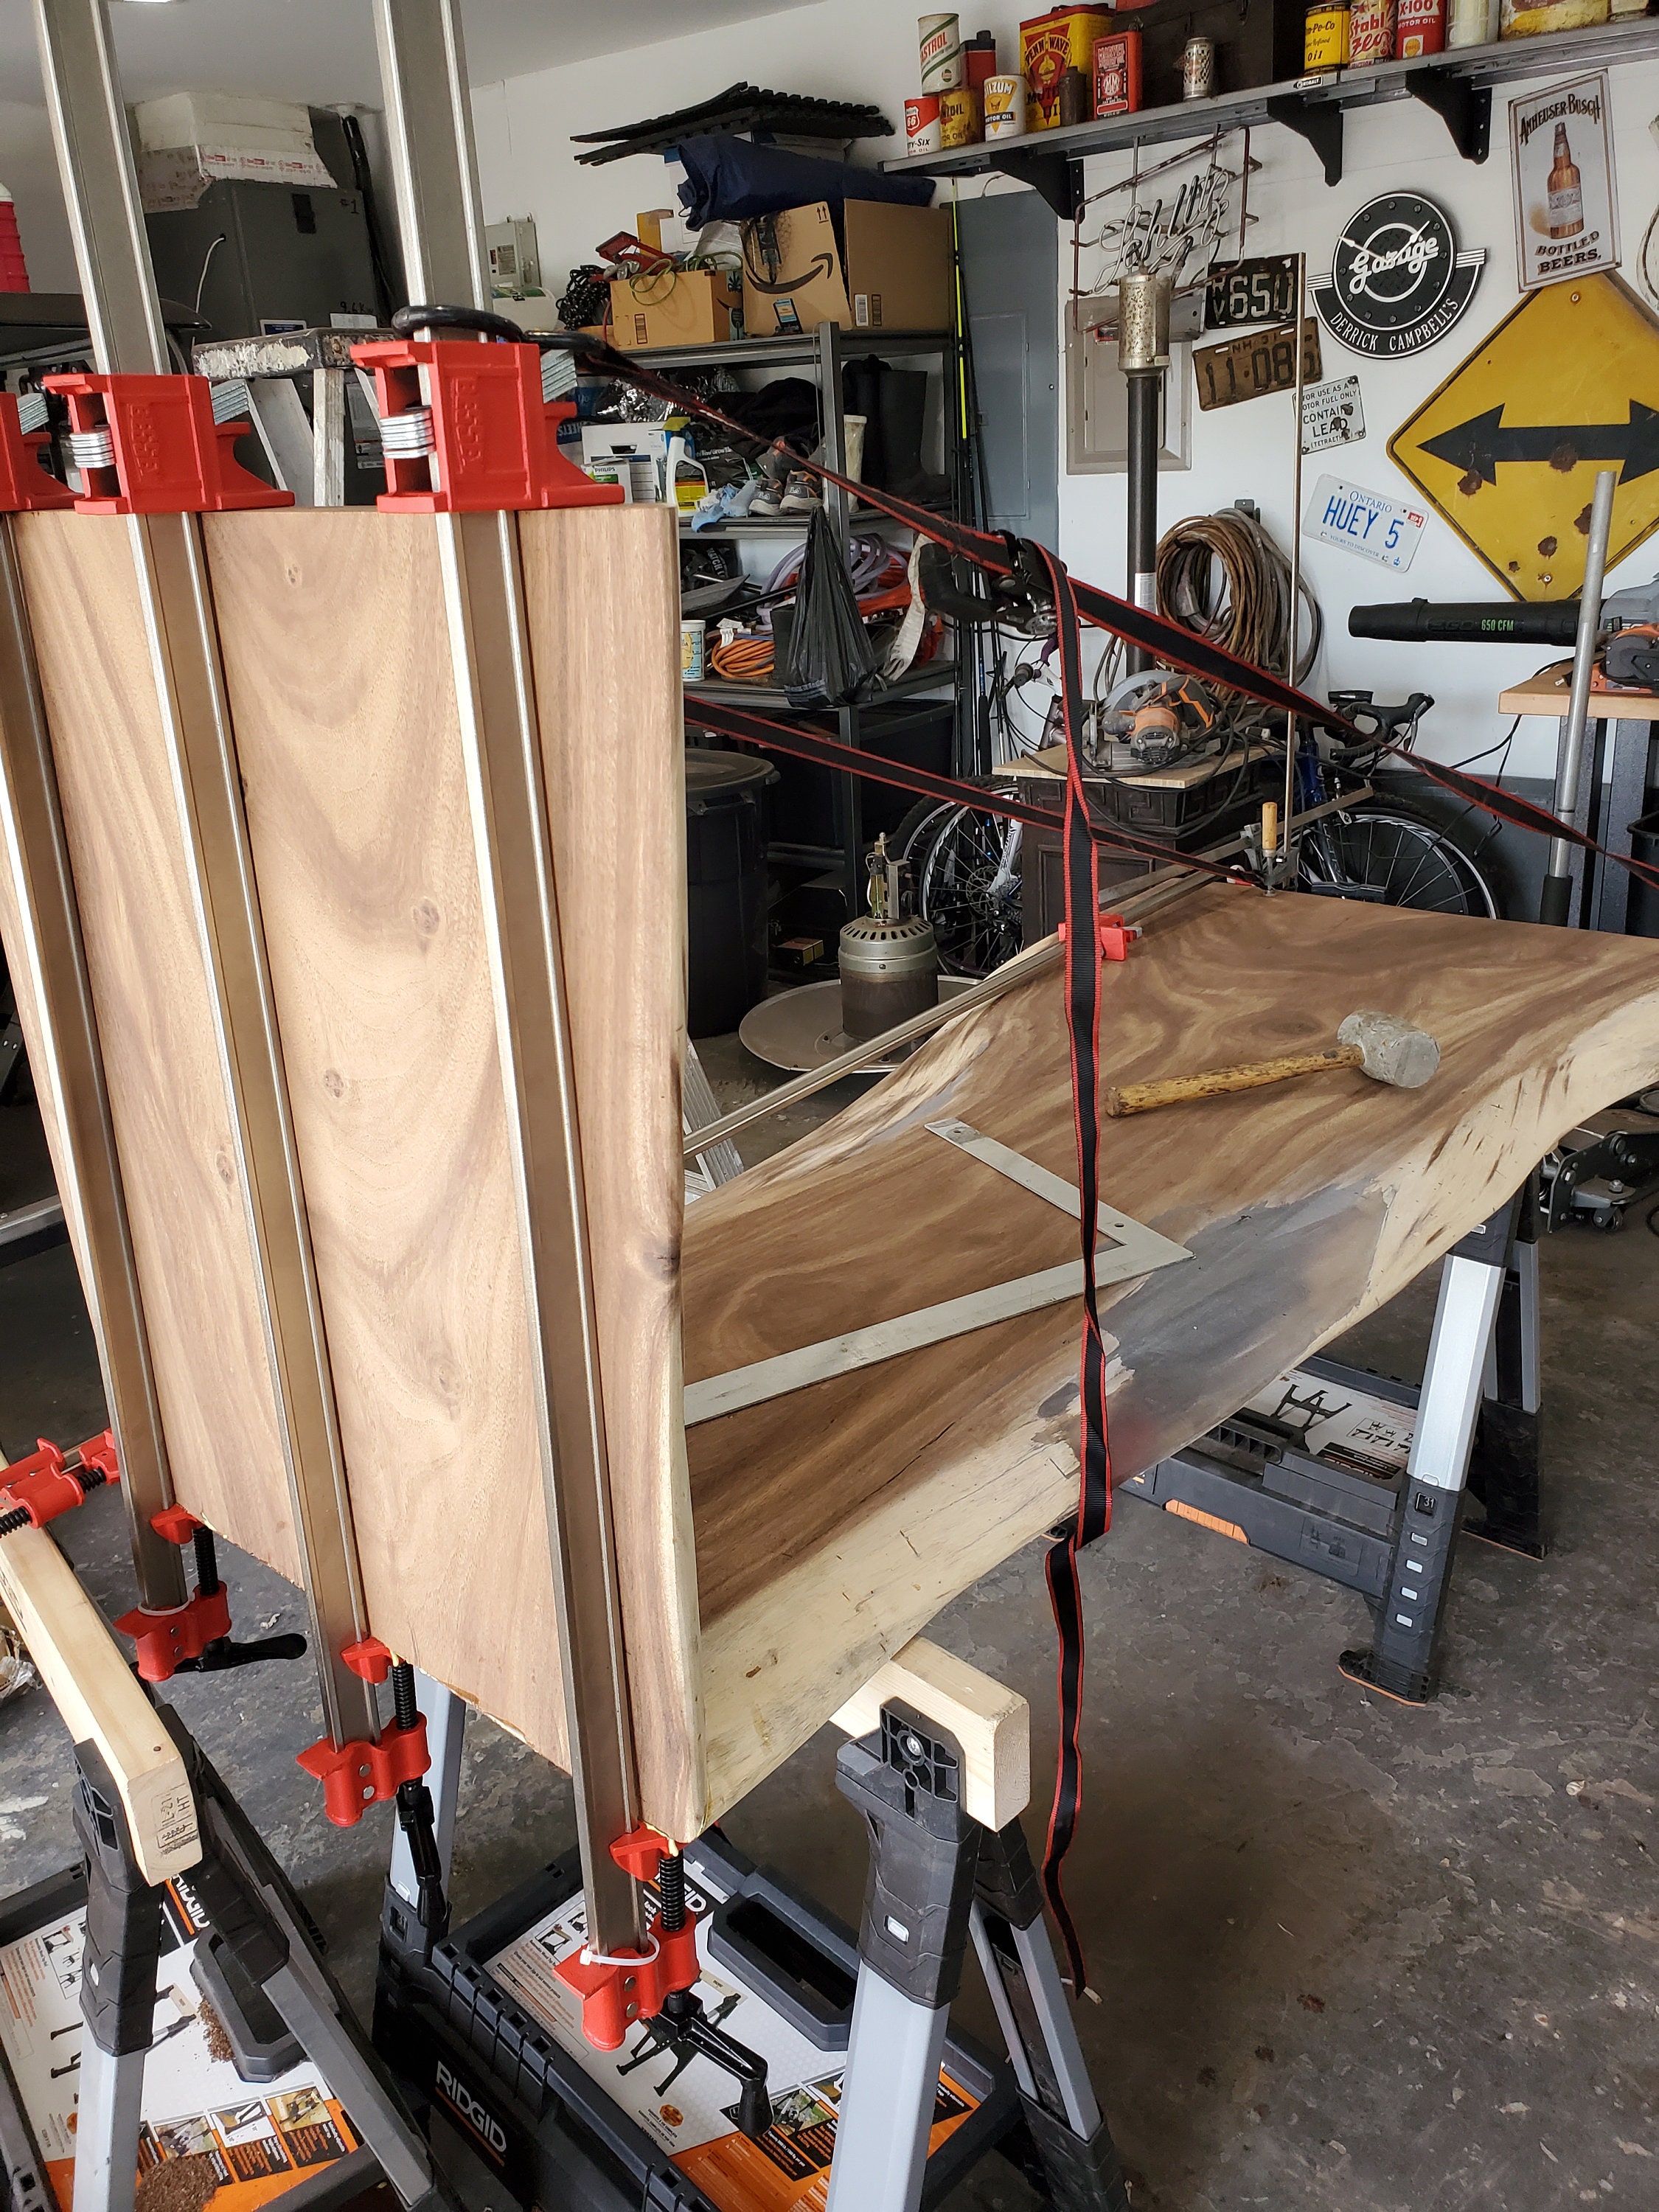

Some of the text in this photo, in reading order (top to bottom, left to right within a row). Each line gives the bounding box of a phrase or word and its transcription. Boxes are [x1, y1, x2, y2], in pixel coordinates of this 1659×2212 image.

[1048, 35, 1070, 55] WAVE
[984, 81, 1014, 96] ILZUM
[907, 116, 917, 126] 66
[1535, 230, 1600, 256] BOTTLED
[1349, 237, 1440, 295] Garage
[1537, 248, 1601, 276] BEERS.
[1329, 297, 1459, 352] DERRICK CAMPBELL'S
[1302, 389, 1357, 411] OTOR FUEL ONLY
[1303, 392, 1315, 401] FOR
[1318, 388, 1330, 397] USE
[1332, 384, 1341, 392] AS
[1303, 403, 1354, 425] CONTAI
[1349, 490, 1393, 514] ONTARIO
[1322, 495, 1405, 549] HUEY 5
[1329, 535, 1346, 546] YOURS
[1354, 544, 1380, 558] DISCOVER
[1481, 619, 1514, 632] 650 CFM
[1423, 1497, 1434, 1508] 31
[177, 1795, 190, 1812] HT
[436, 2059, 507, 2153] RIDGID
